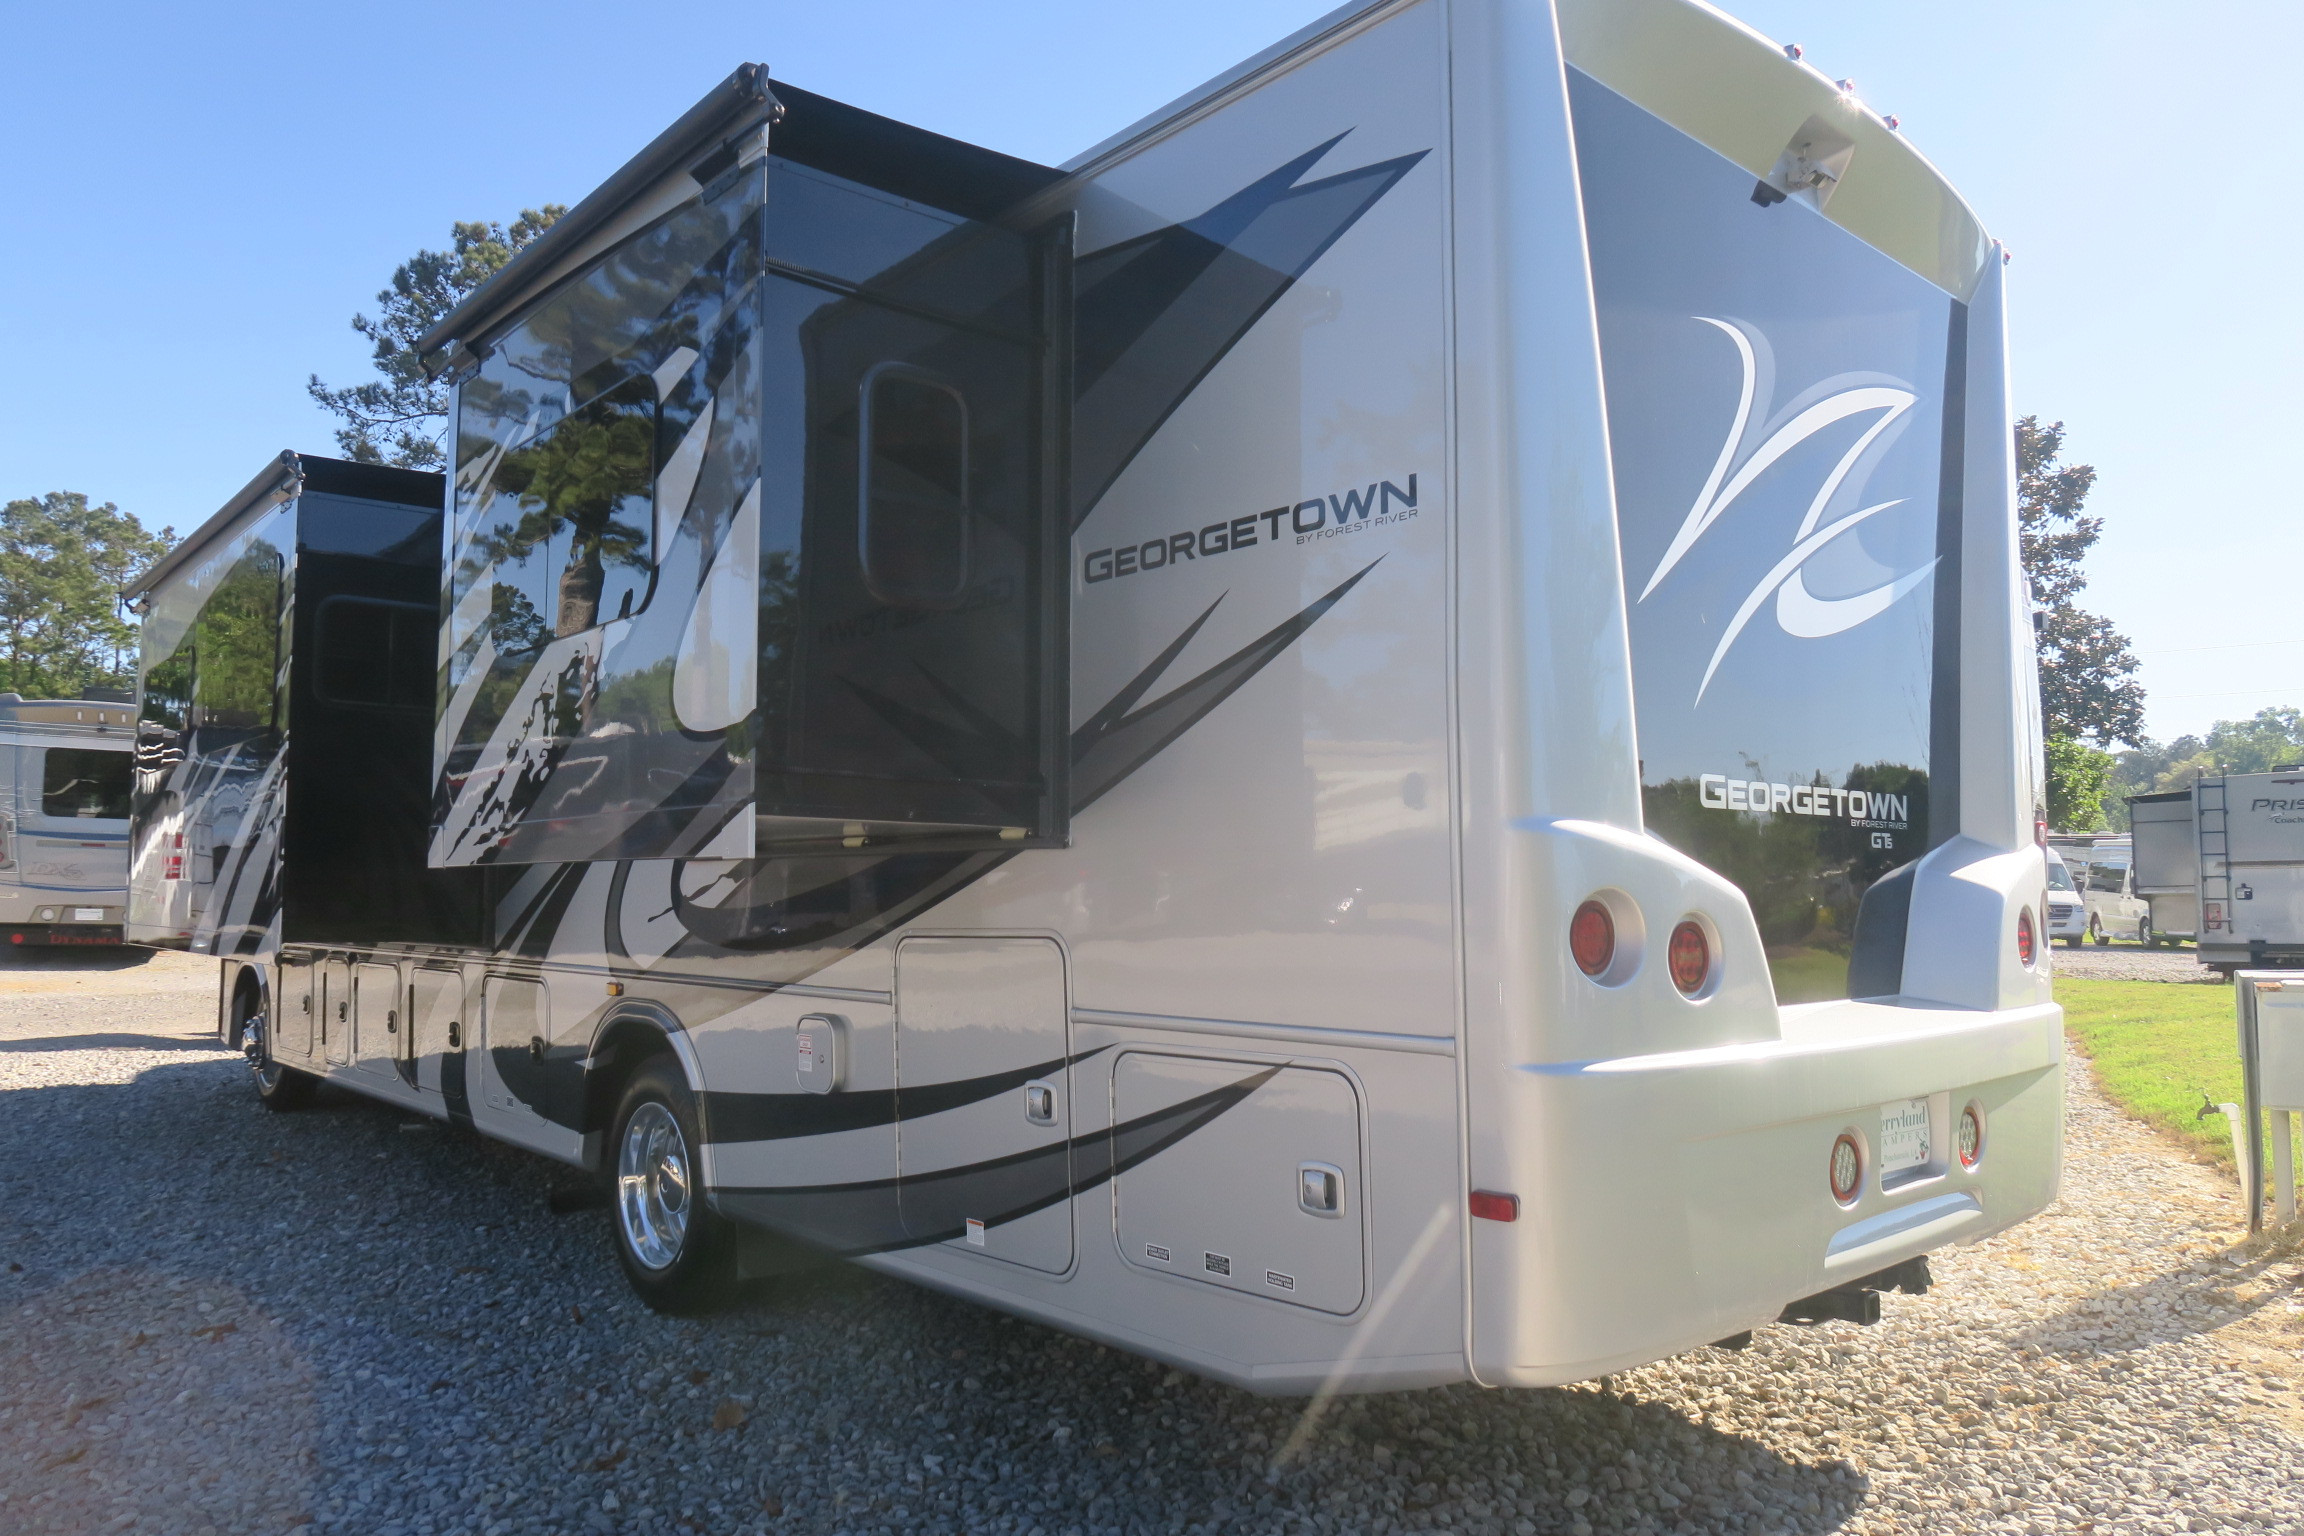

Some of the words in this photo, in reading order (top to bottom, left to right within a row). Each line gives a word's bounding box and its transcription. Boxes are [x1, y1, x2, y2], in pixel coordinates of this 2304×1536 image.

[1084, 473, 1418, 584] GEORGETOWN
[1296, 534, 1313, 545] BY
[1316, 519, 1372, 540] FOREST
[1374, 509, 1418, 527] RIVER
[1700, 773, 1908, 822] GEORGETOWN
[1850, 818, 1860, 827] BY
[1861, 820, 1888, 829] FOREST
[1888, 821, 1908, 830] RIVER
[2274, 816, 2304, 824] Coach
